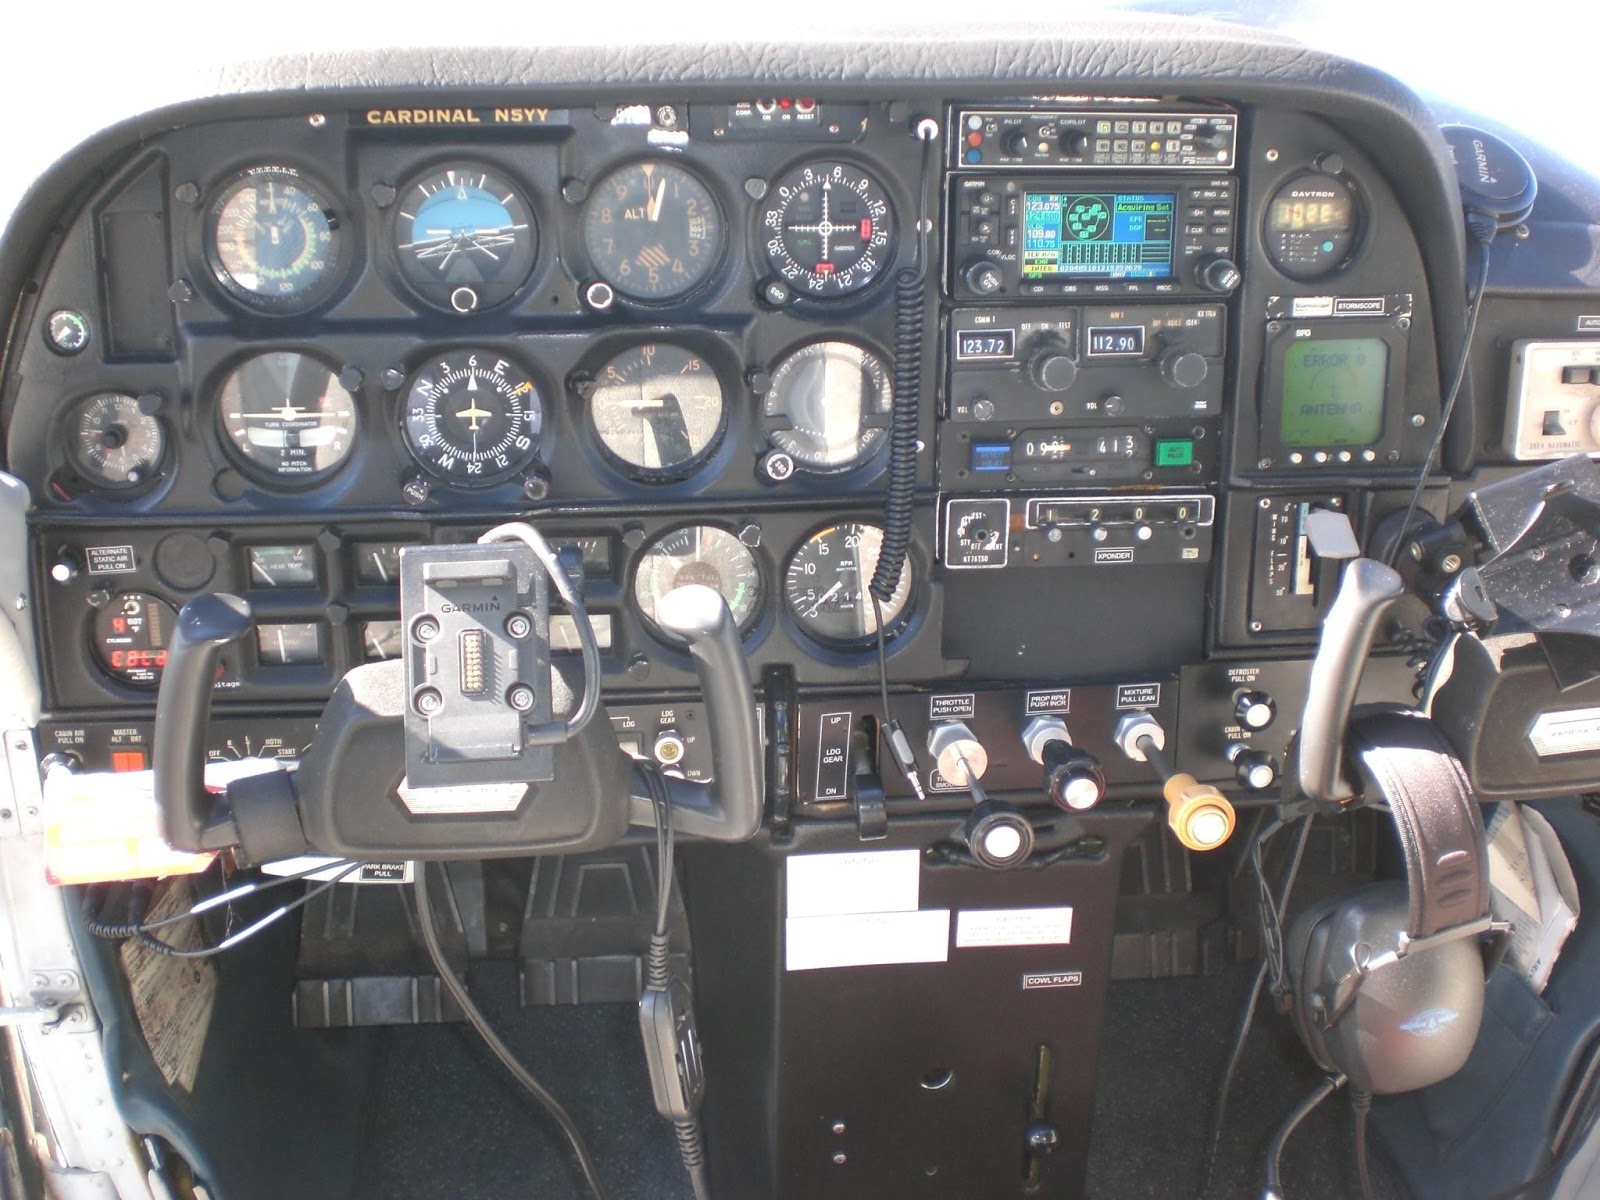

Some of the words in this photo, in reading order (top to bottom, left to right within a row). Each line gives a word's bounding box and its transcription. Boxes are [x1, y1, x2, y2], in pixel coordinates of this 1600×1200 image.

[367, 108, 480, 124] CARDINAL
[495, 108, 548, 122] N5YY
[1472, 139, 1490, 183] GARMIN
[804, 168, 814, 181] 3
[833, 166, 842, 178] 6
[858, 178, 869, 190] 9
[779, 186, 790, 197] 0
[873, 199, 887, 216] 12
[1026, 202, 1060, 210] 123.075
[624, 207, 645, 219] ALT
[766, 210, 778, 227] 33
[875, 230, 888, 246] 15
[767, 239, 781, 256] 30
[620, 259, 630, 275] 6
[672, 258, 683, 273] 4
[861, 257, 876, 272] 18
[648, 267, 659, 283] 5
[781, 264, 799, 279] 27
[809, 278, 824, 290] 24
[837, 274, 852, 289] 21
[770, 286, 785, 299] OBS
[1021, 323, 1031, 331] OFF
[963, 339, 1004, 353] 123.72
[1093, 336, 1135, 351] 112.90
[643, 345, 655, 356] 10
[468, 355, 477, 366] 6
[688, 359, 700, 370] 15
[1303, 353, 1348, 367] ERROR
[440, 362, 450, 373] 3
[493, 359, 509, 375] E
[607, 367, 616, 378] 5
[416, 379, 433, 396] N
[412, 407, 424, 422] 33
[523, 410, 535, 421] 15
[1301, 403, 1362, 416] ANTENNA
[334, 441, 342, 450] R
[419, 434, 434, 449] 30
[515, 435, 530, 450] S
[243, 444, 251, 452] L
[437, 454, 455, 469] W
[495, 455, 509, 468] 21
[467, 462, 482, 474] 24
[406, 487, 424, 500] PUSH
[1091, 509, 1099, 520] 2
[1136, 508, 1143, 519] 0
[1179, 507, 1186, 518] 0
[845, 535, 860, 548] 20
[91, 548, 128, 556] ALTERNATE
[819, 543, 830, 555] 15
[1098, 552, 1131, 560] XPONDER
[804, 563, 816, 574] 10
[807, 589, 815, 600] 5
[441, 602, 500, 613] GARMIN
[1228, 668, 1260, 676] DEFROSTER
[1051, 694, 1066, 702] RPM
[1124, 688, 1153, 696] MIXTURE
[935, 698, 970, 706] THROTTLE
[1050, 699, 1066, 707] INCR
[1121, 695, 1137, 703] PULL
[661, 710, 674, 718] LDG
[933, 706, 952, 714] PUSH
[953, 705, 971, 713] OPEN
[623, 720, 635, 728] LDG
[130, 735, 142, 743] BAT
[826, 748, 841, 756] LDG
[823, 755, 843, 763] GEAR
[381, 863, 404, 871] BRAKE
[1028, 976, 1051, 985] COWL
[1053, 975, 1079, 983] FLAPS
